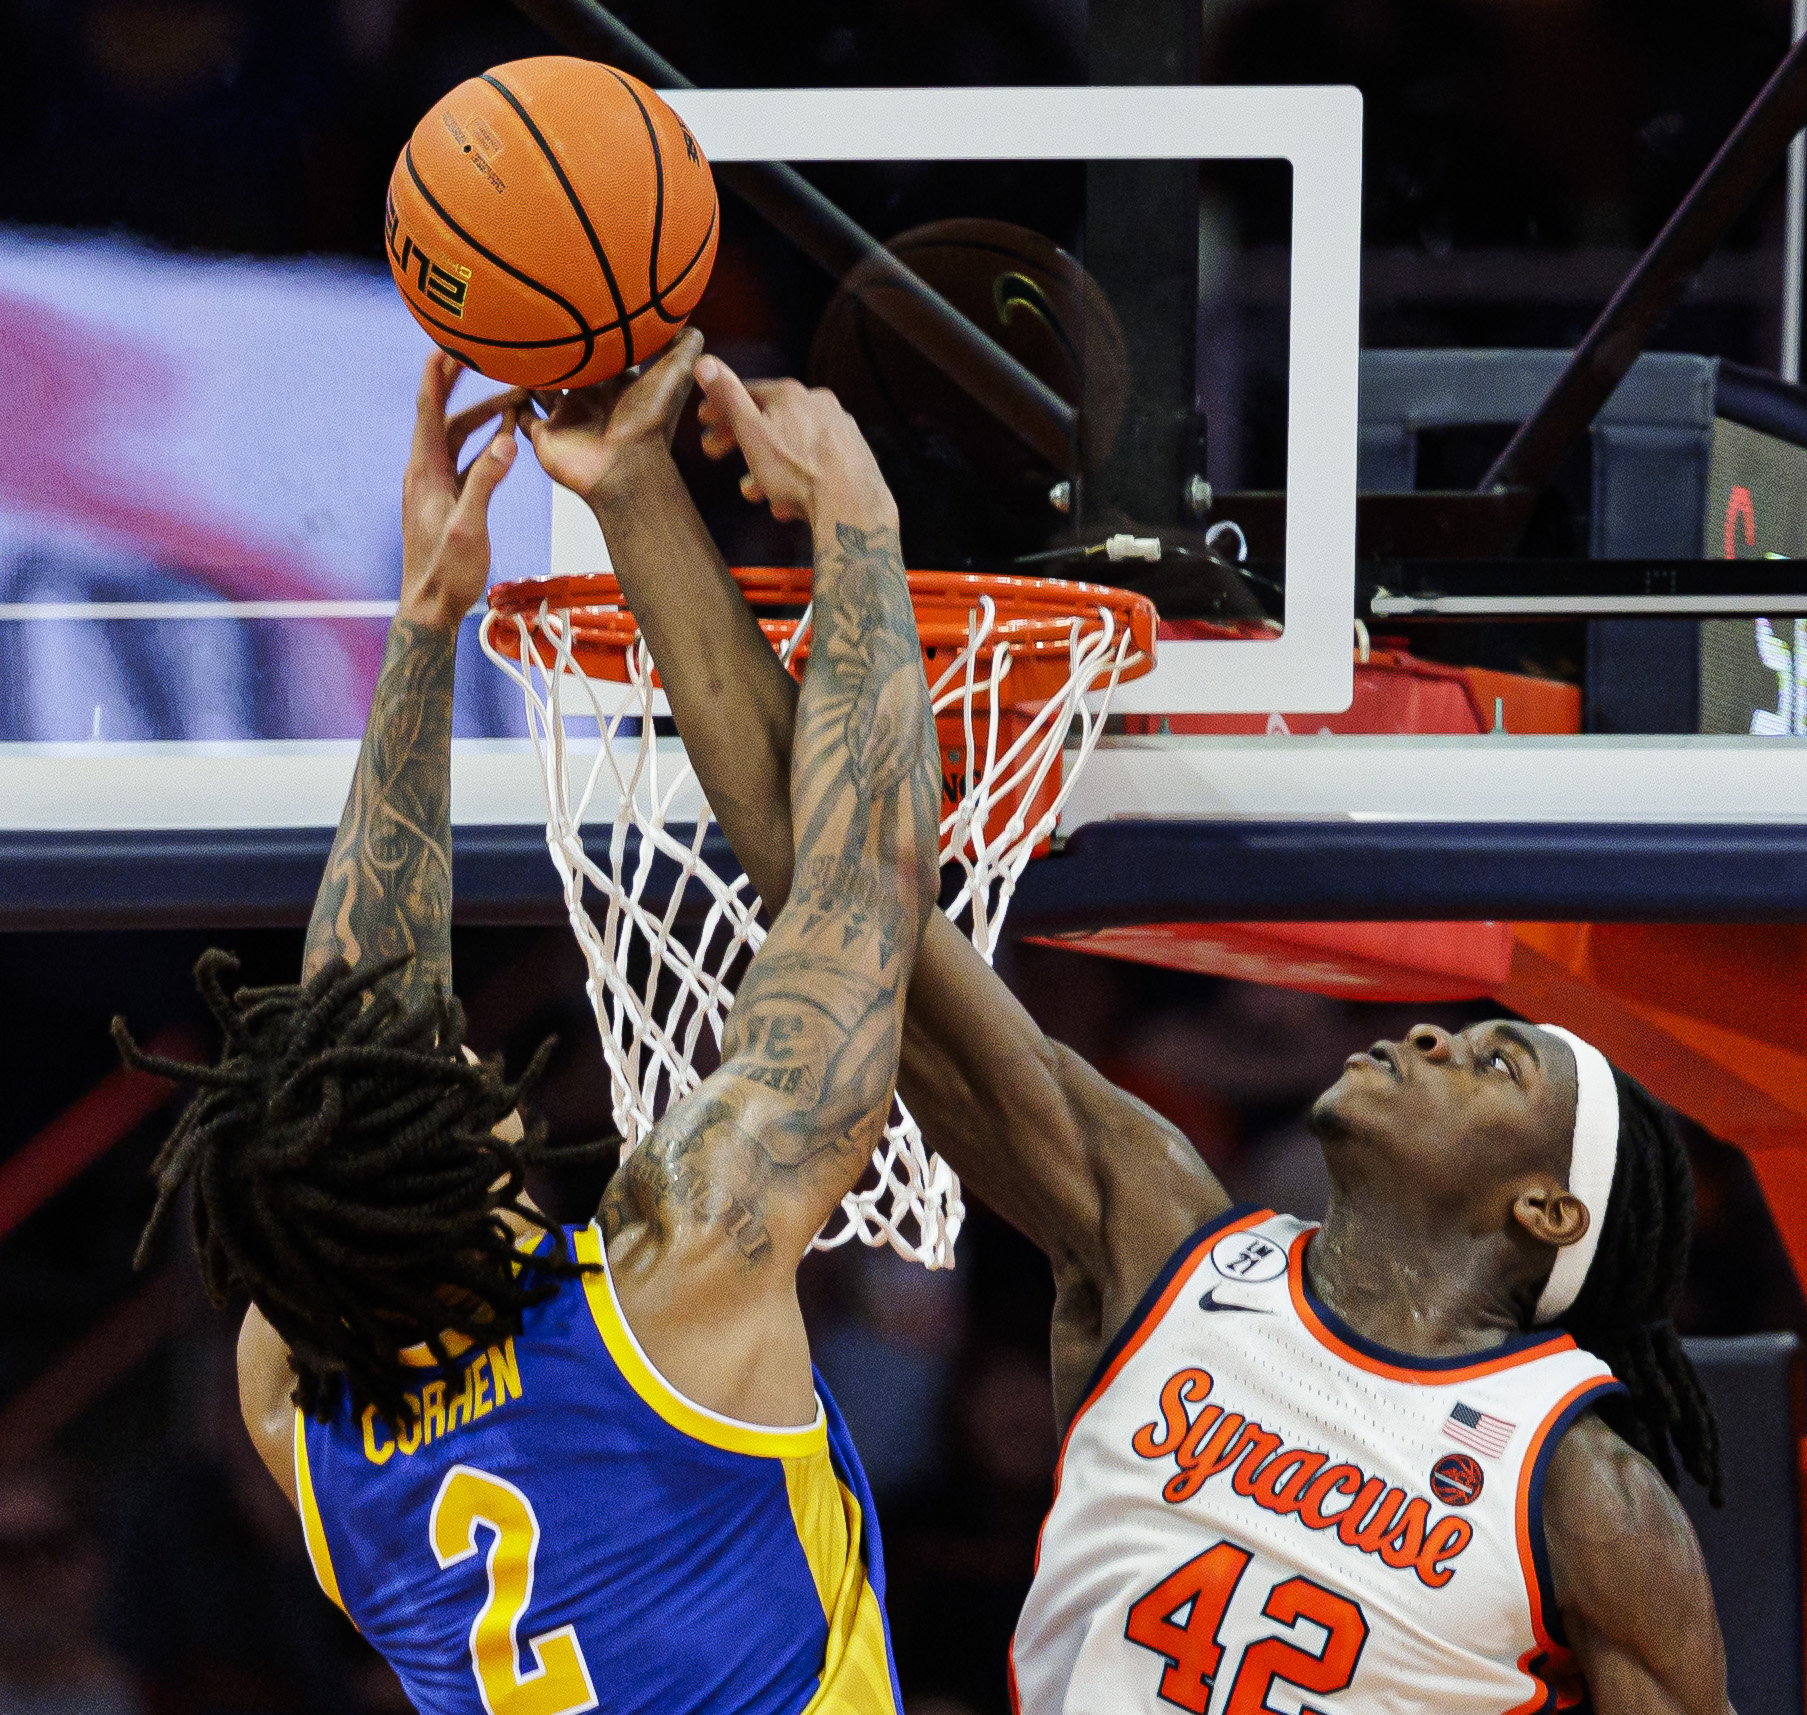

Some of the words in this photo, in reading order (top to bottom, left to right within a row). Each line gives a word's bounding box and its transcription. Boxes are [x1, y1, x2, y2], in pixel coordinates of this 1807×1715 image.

[1225, 1252, 1260, 1276] 21
[1131, 1367, 1474, 1589] Syracuse
[428, 1463, 599, 1715] 2
[1124, 1540, 1369, 1715] 42
